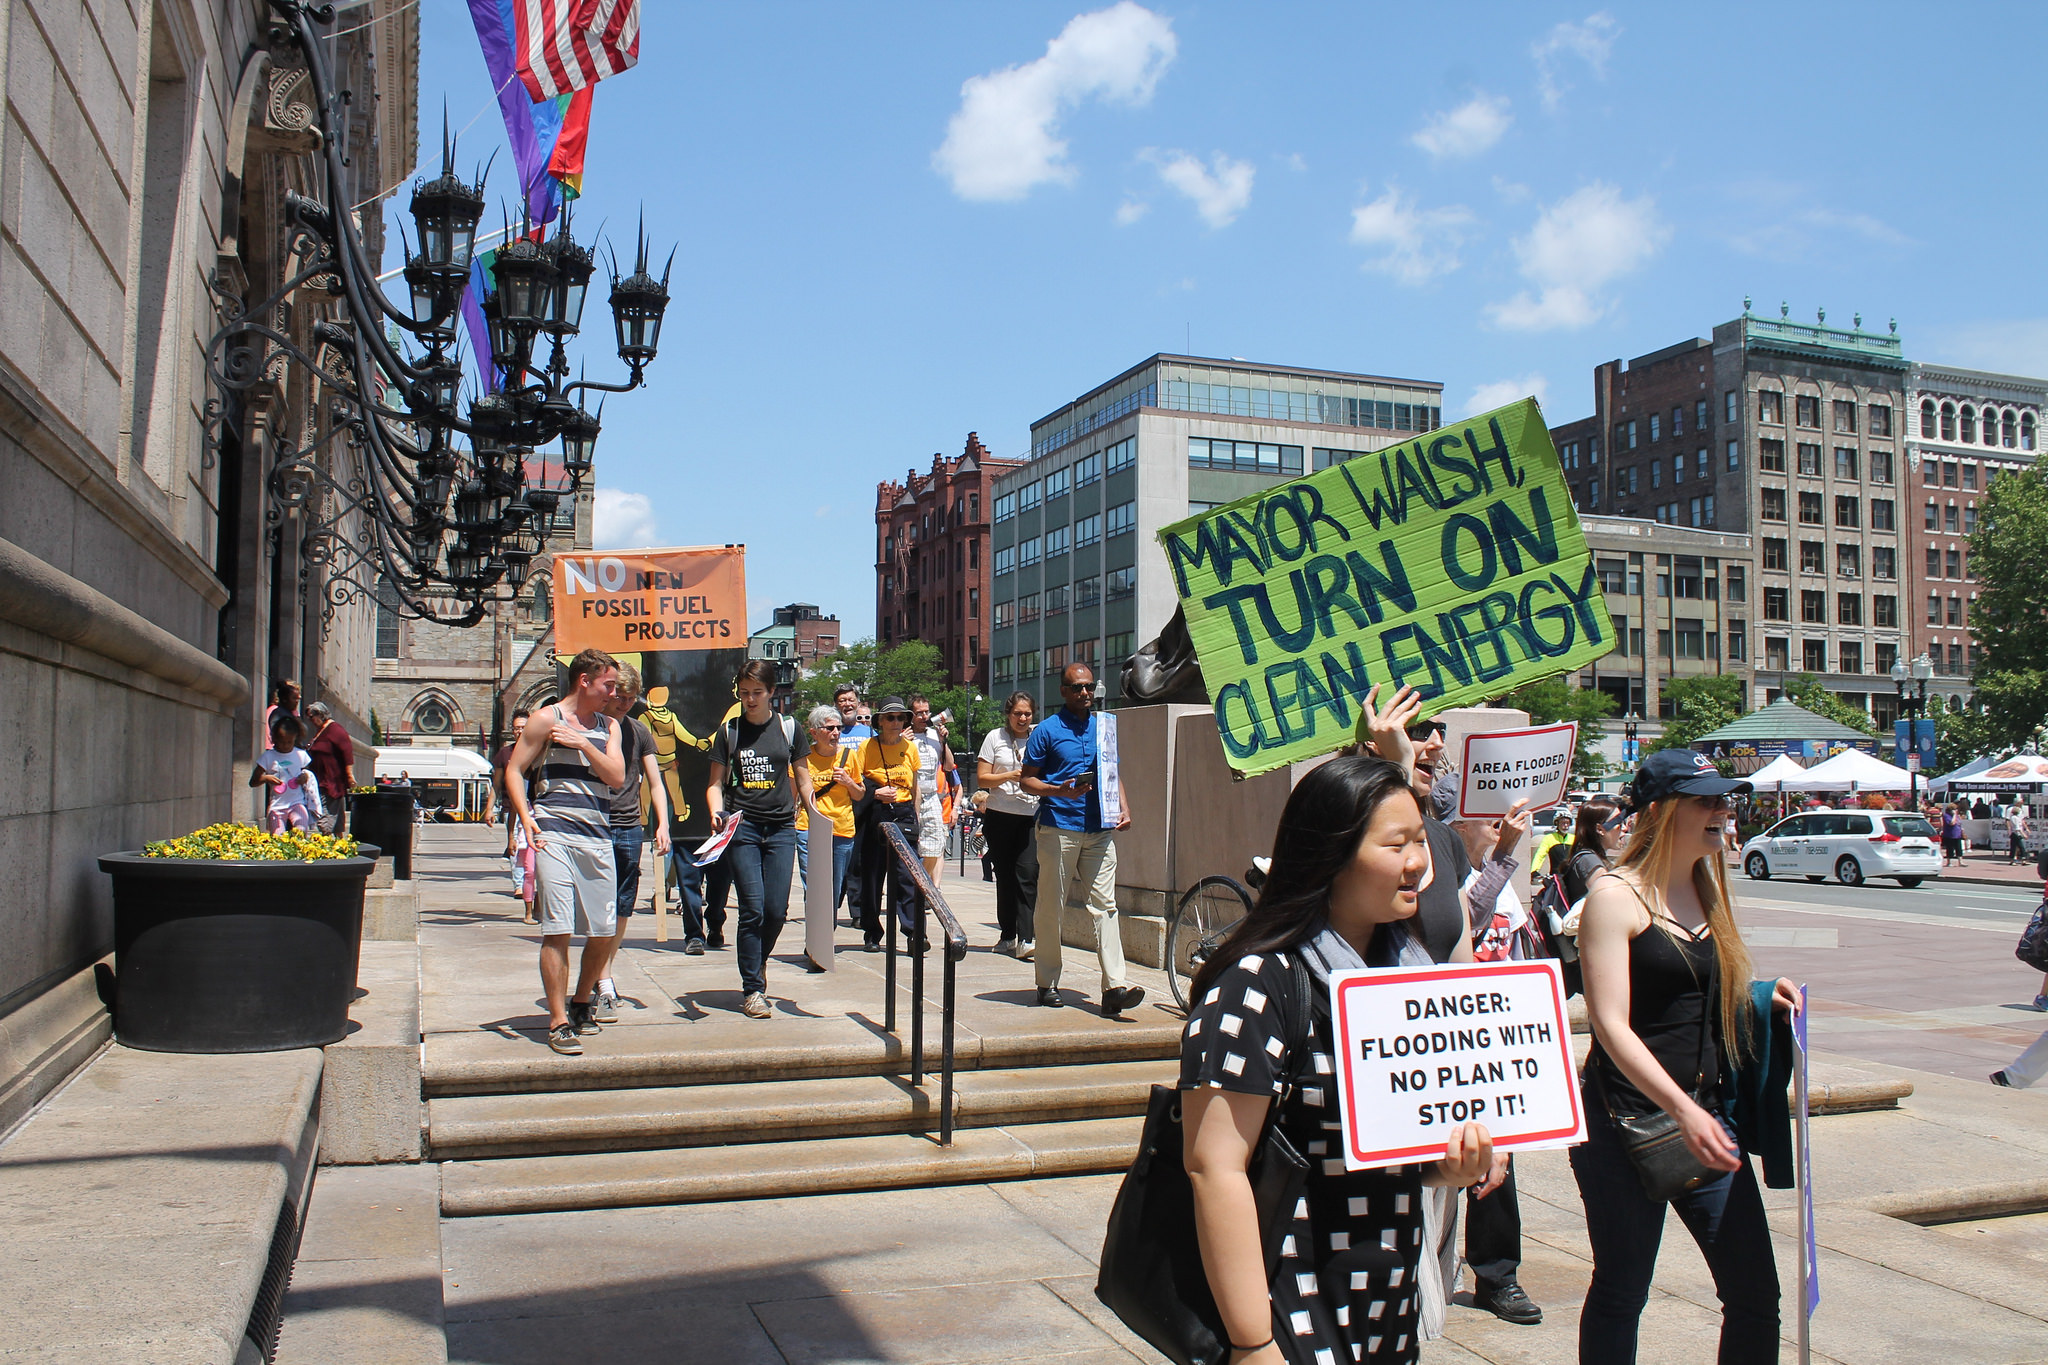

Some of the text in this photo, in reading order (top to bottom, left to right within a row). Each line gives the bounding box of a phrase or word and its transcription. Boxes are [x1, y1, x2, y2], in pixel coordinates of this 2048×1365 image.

[1166, 416, 1526, 598] MAYOR WALSH,
[564, 556, 683, 595] NO NEW
[1202, 485, 1559, 665] TURN ON
[582, 596, 713, 618] FOSSIL FUEL
[625, 619, 731, 642] PROJECTS
[1214, 564, 1603, 760] CLEAN ENERGY
[740, 750, 755, 758] NO
[740, 756, 769, 766] MORE
[1471, 753, 1566, 774] AREA FLOODED,
[1730, 747, 1757, 757] POPS
[742, 764, 775, 774] FOSSIL
[742, 773, 766, 781] FUEL
[1477, 770, 1560, 790] DO NOT BUILD
[1405, 992, 1511, 1020] DANGER:
[1360, 1022, 1552, 1060] FLOODING WITH
[1390, 1057, 1539, 1093] NO PLAN TO
[1418, 1093, 1526, 1126] STOP IT!
